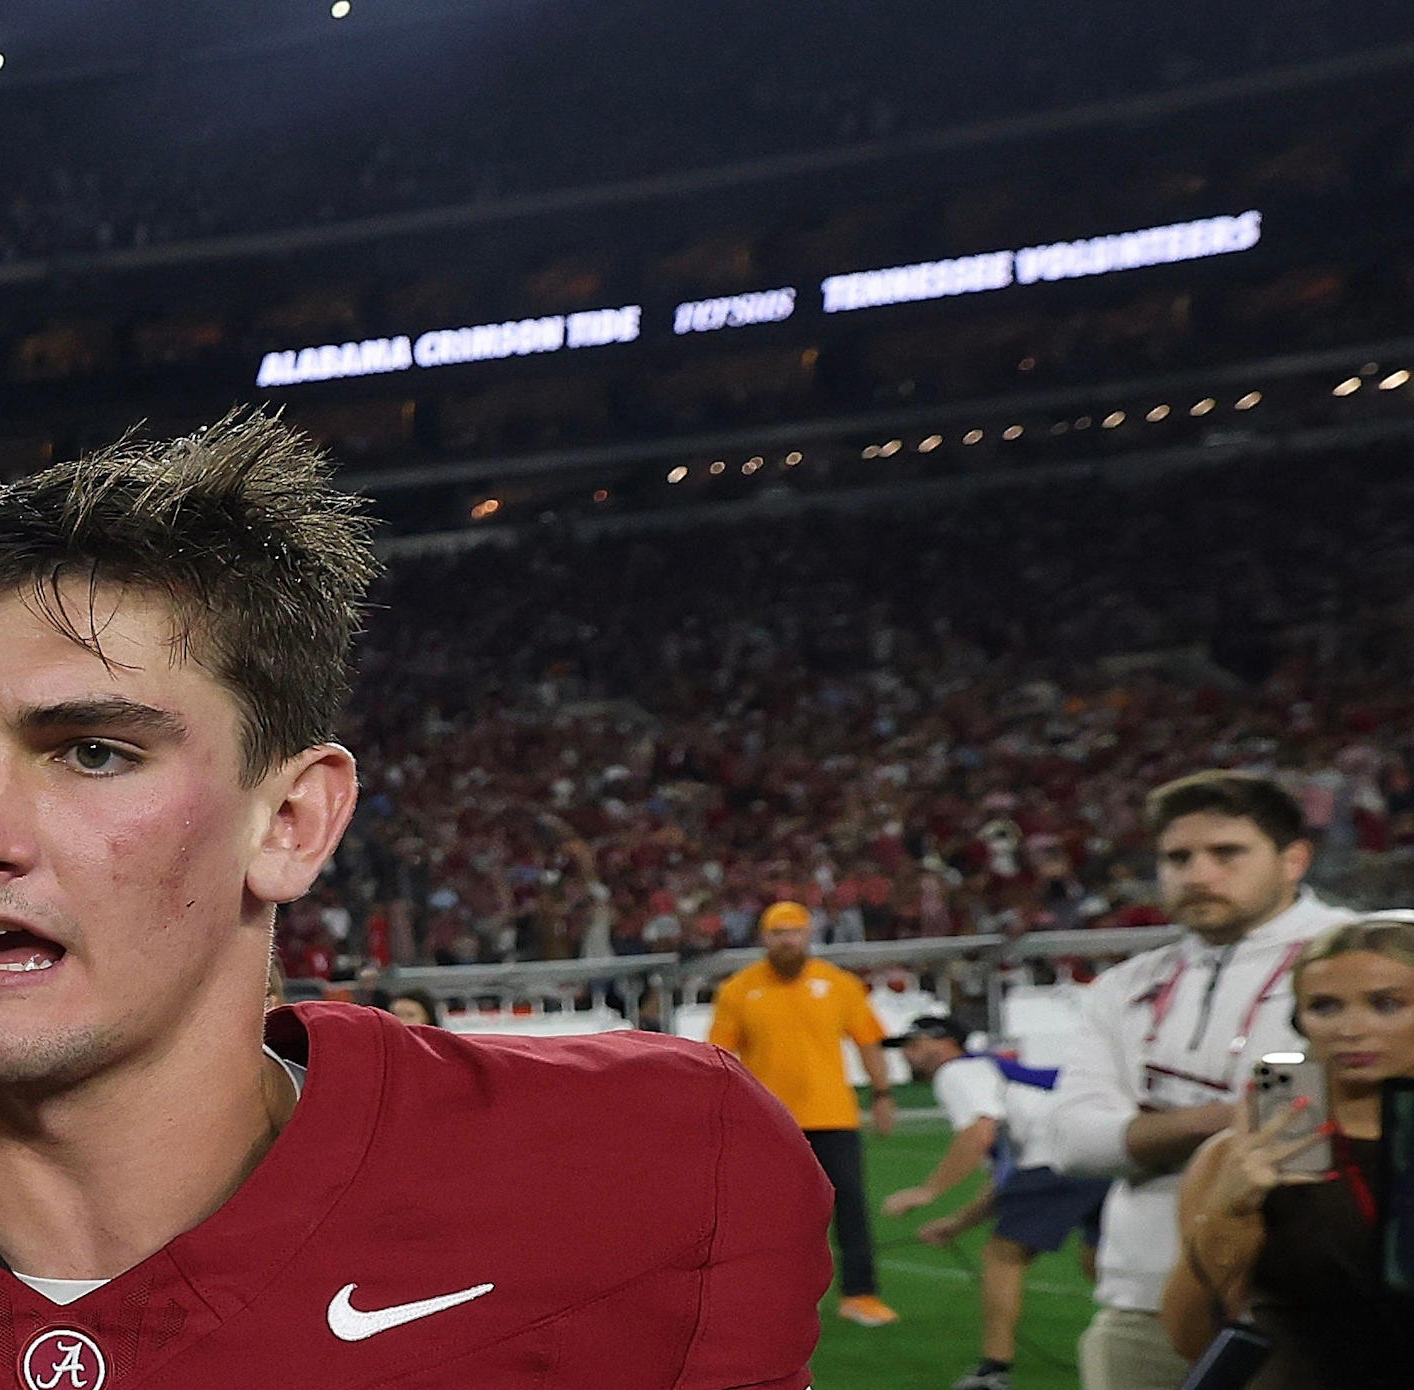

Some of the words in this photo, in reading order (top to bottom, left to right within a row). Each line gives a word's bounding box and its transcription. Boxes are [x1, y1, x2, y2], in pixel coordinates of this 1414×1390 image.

[821, 250, 1014, 313] TENNESSEE
[1014, 209, 1262, 285] VOLUNTEERS
[256, 335, 413, 387] ALABAMA
[413, 315, 565, 368] CRIMSON
[566, 304, 642, 349] TIDE
